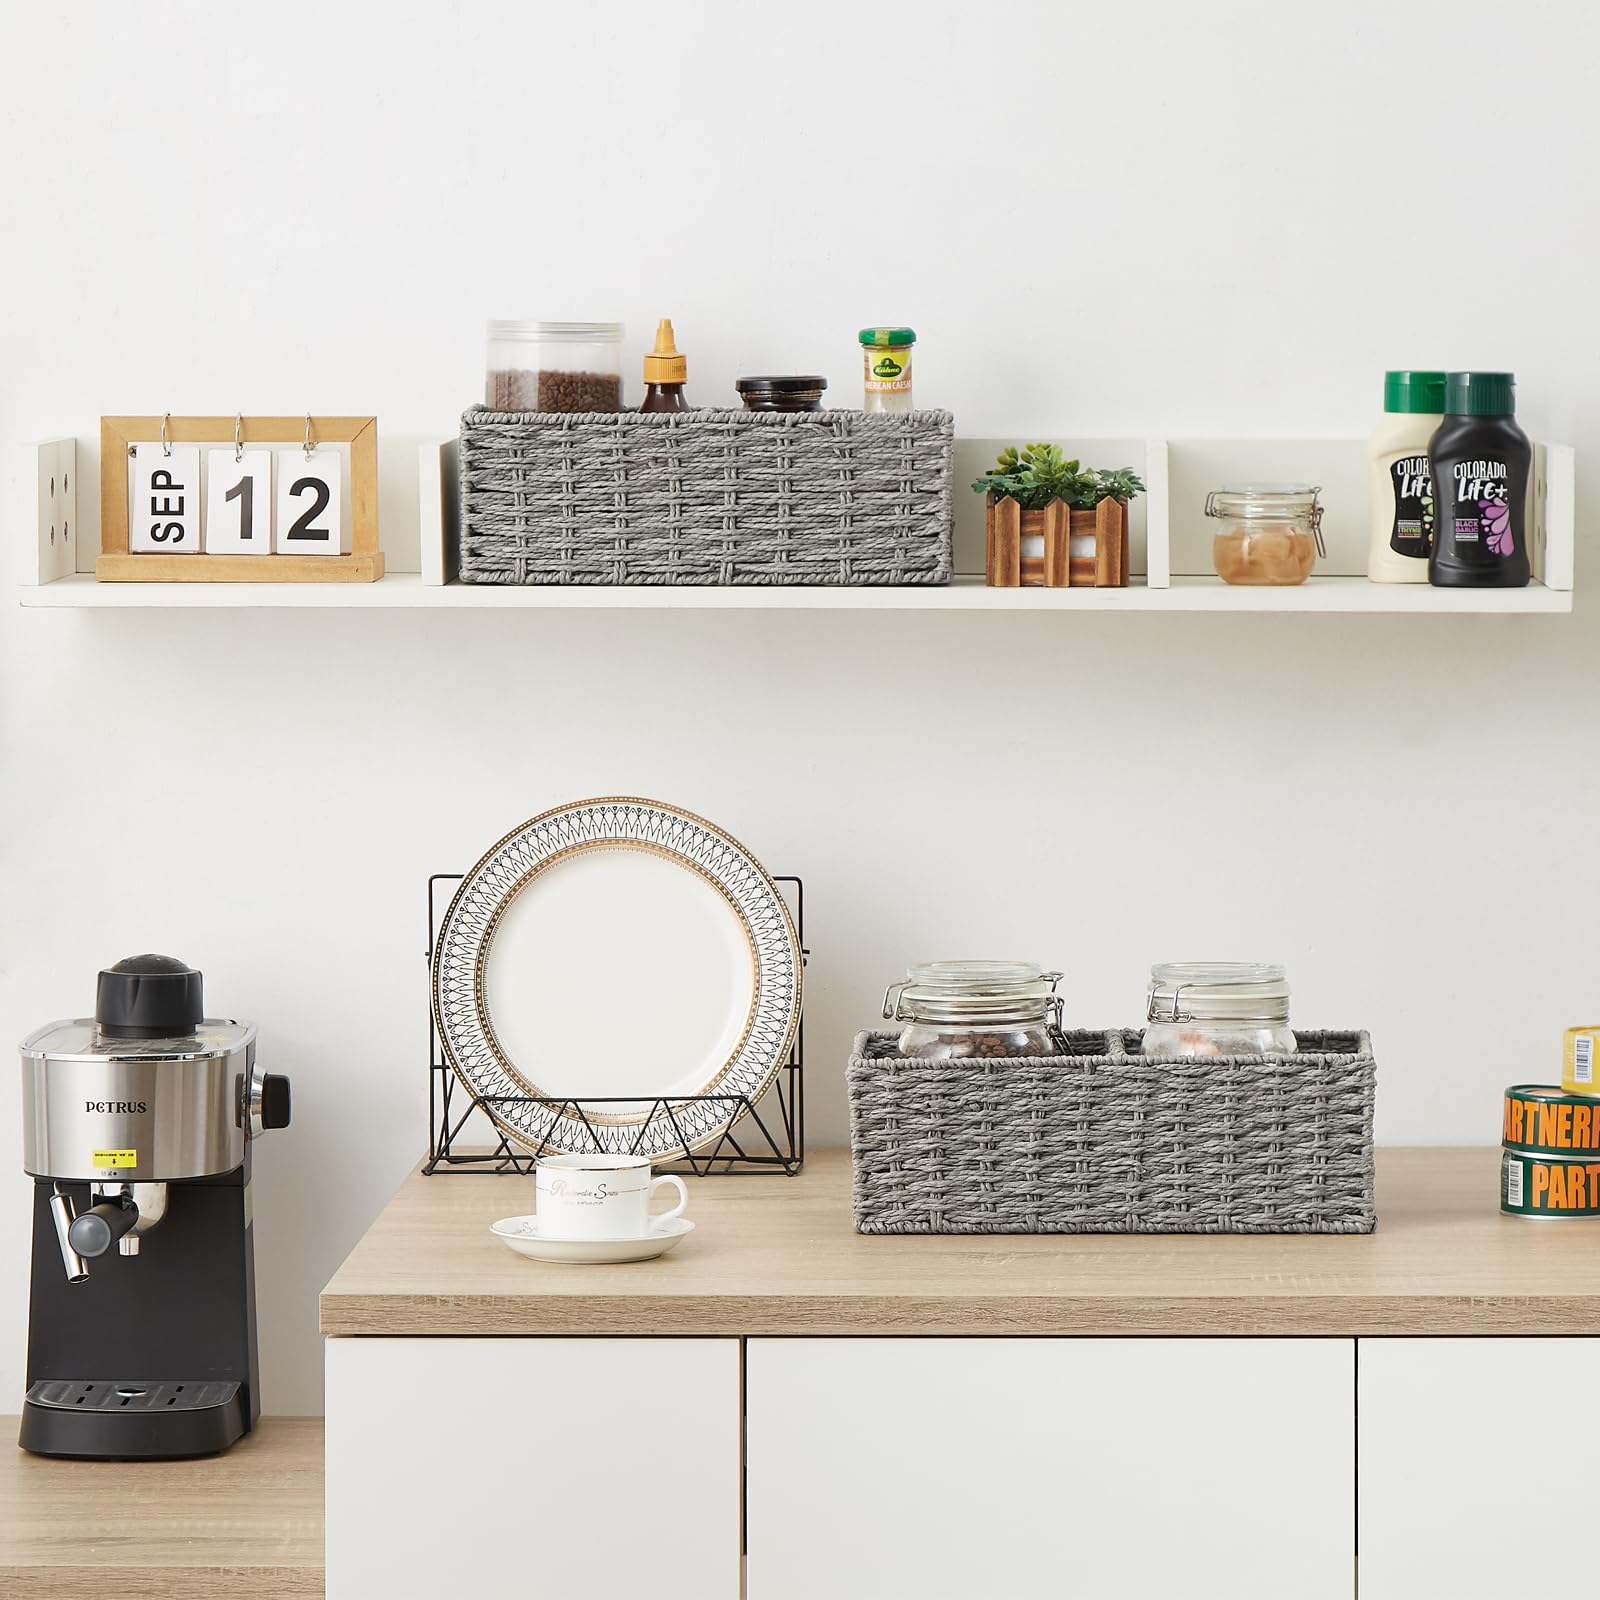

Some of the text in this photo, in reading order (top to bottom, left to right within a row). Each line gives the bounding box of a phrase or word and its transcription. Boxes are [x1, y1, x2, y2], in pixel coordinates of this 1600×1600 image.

[1397, 457, 1430, 476] COLOR
[1454, 460, 1506, 479] COLORADO
[150, 469, 185, 543] SEP
[85, 1101, 147, 1114] PETRUS
[1532, 1164, 1600, 1209] PART
